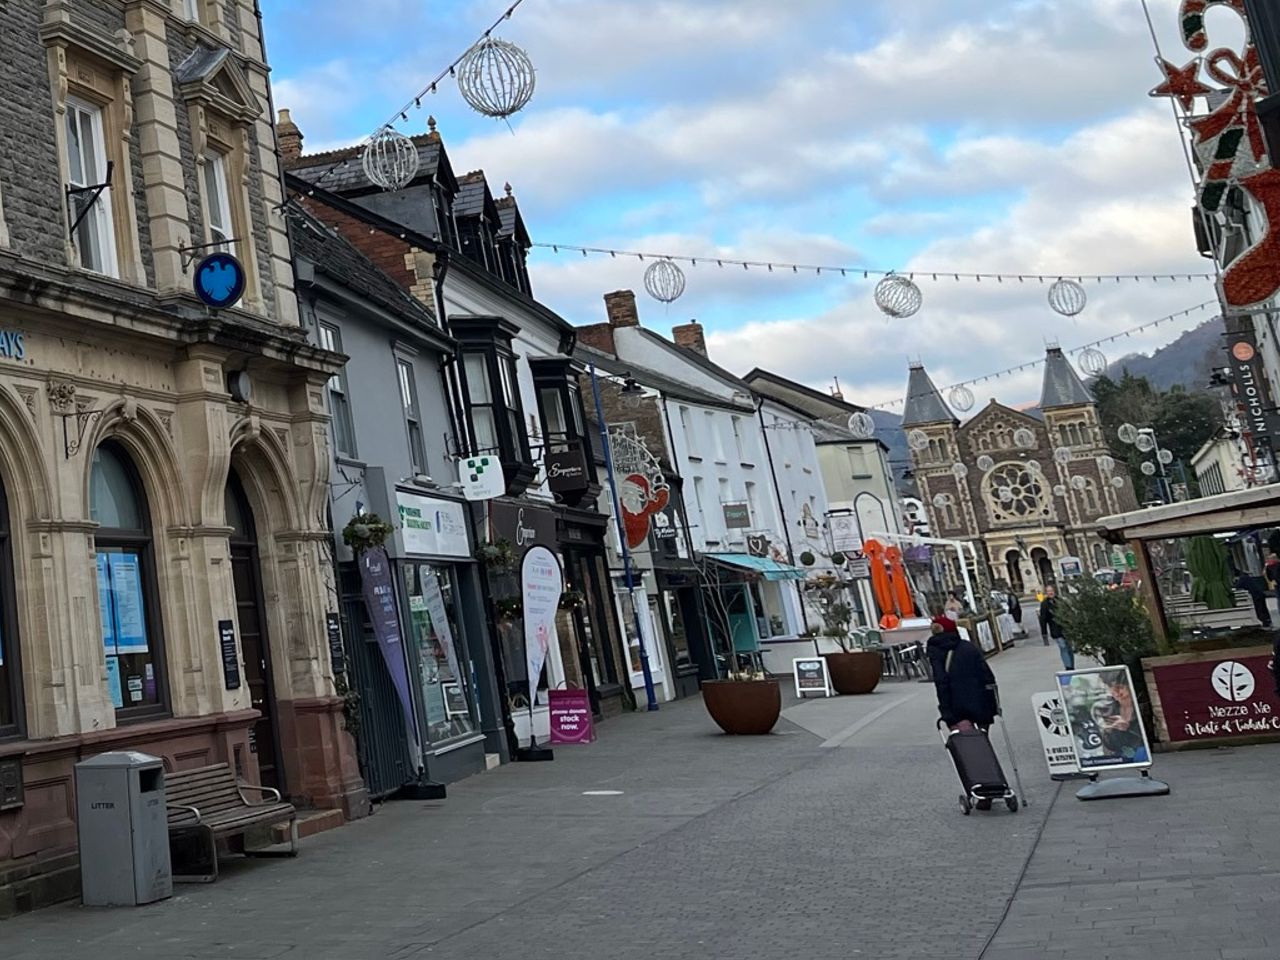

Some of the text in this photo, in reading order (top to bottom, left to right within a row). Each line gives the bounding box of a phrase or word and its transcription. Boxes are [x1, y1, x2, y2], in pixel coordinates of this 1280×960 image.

[1239, 364, 1267, 432] NICHOLLS
[1208, 701, 1271, 718] Mezze Me
[560, 714, 580, 723] stock
[91, 802, 115, 810] LITTER
